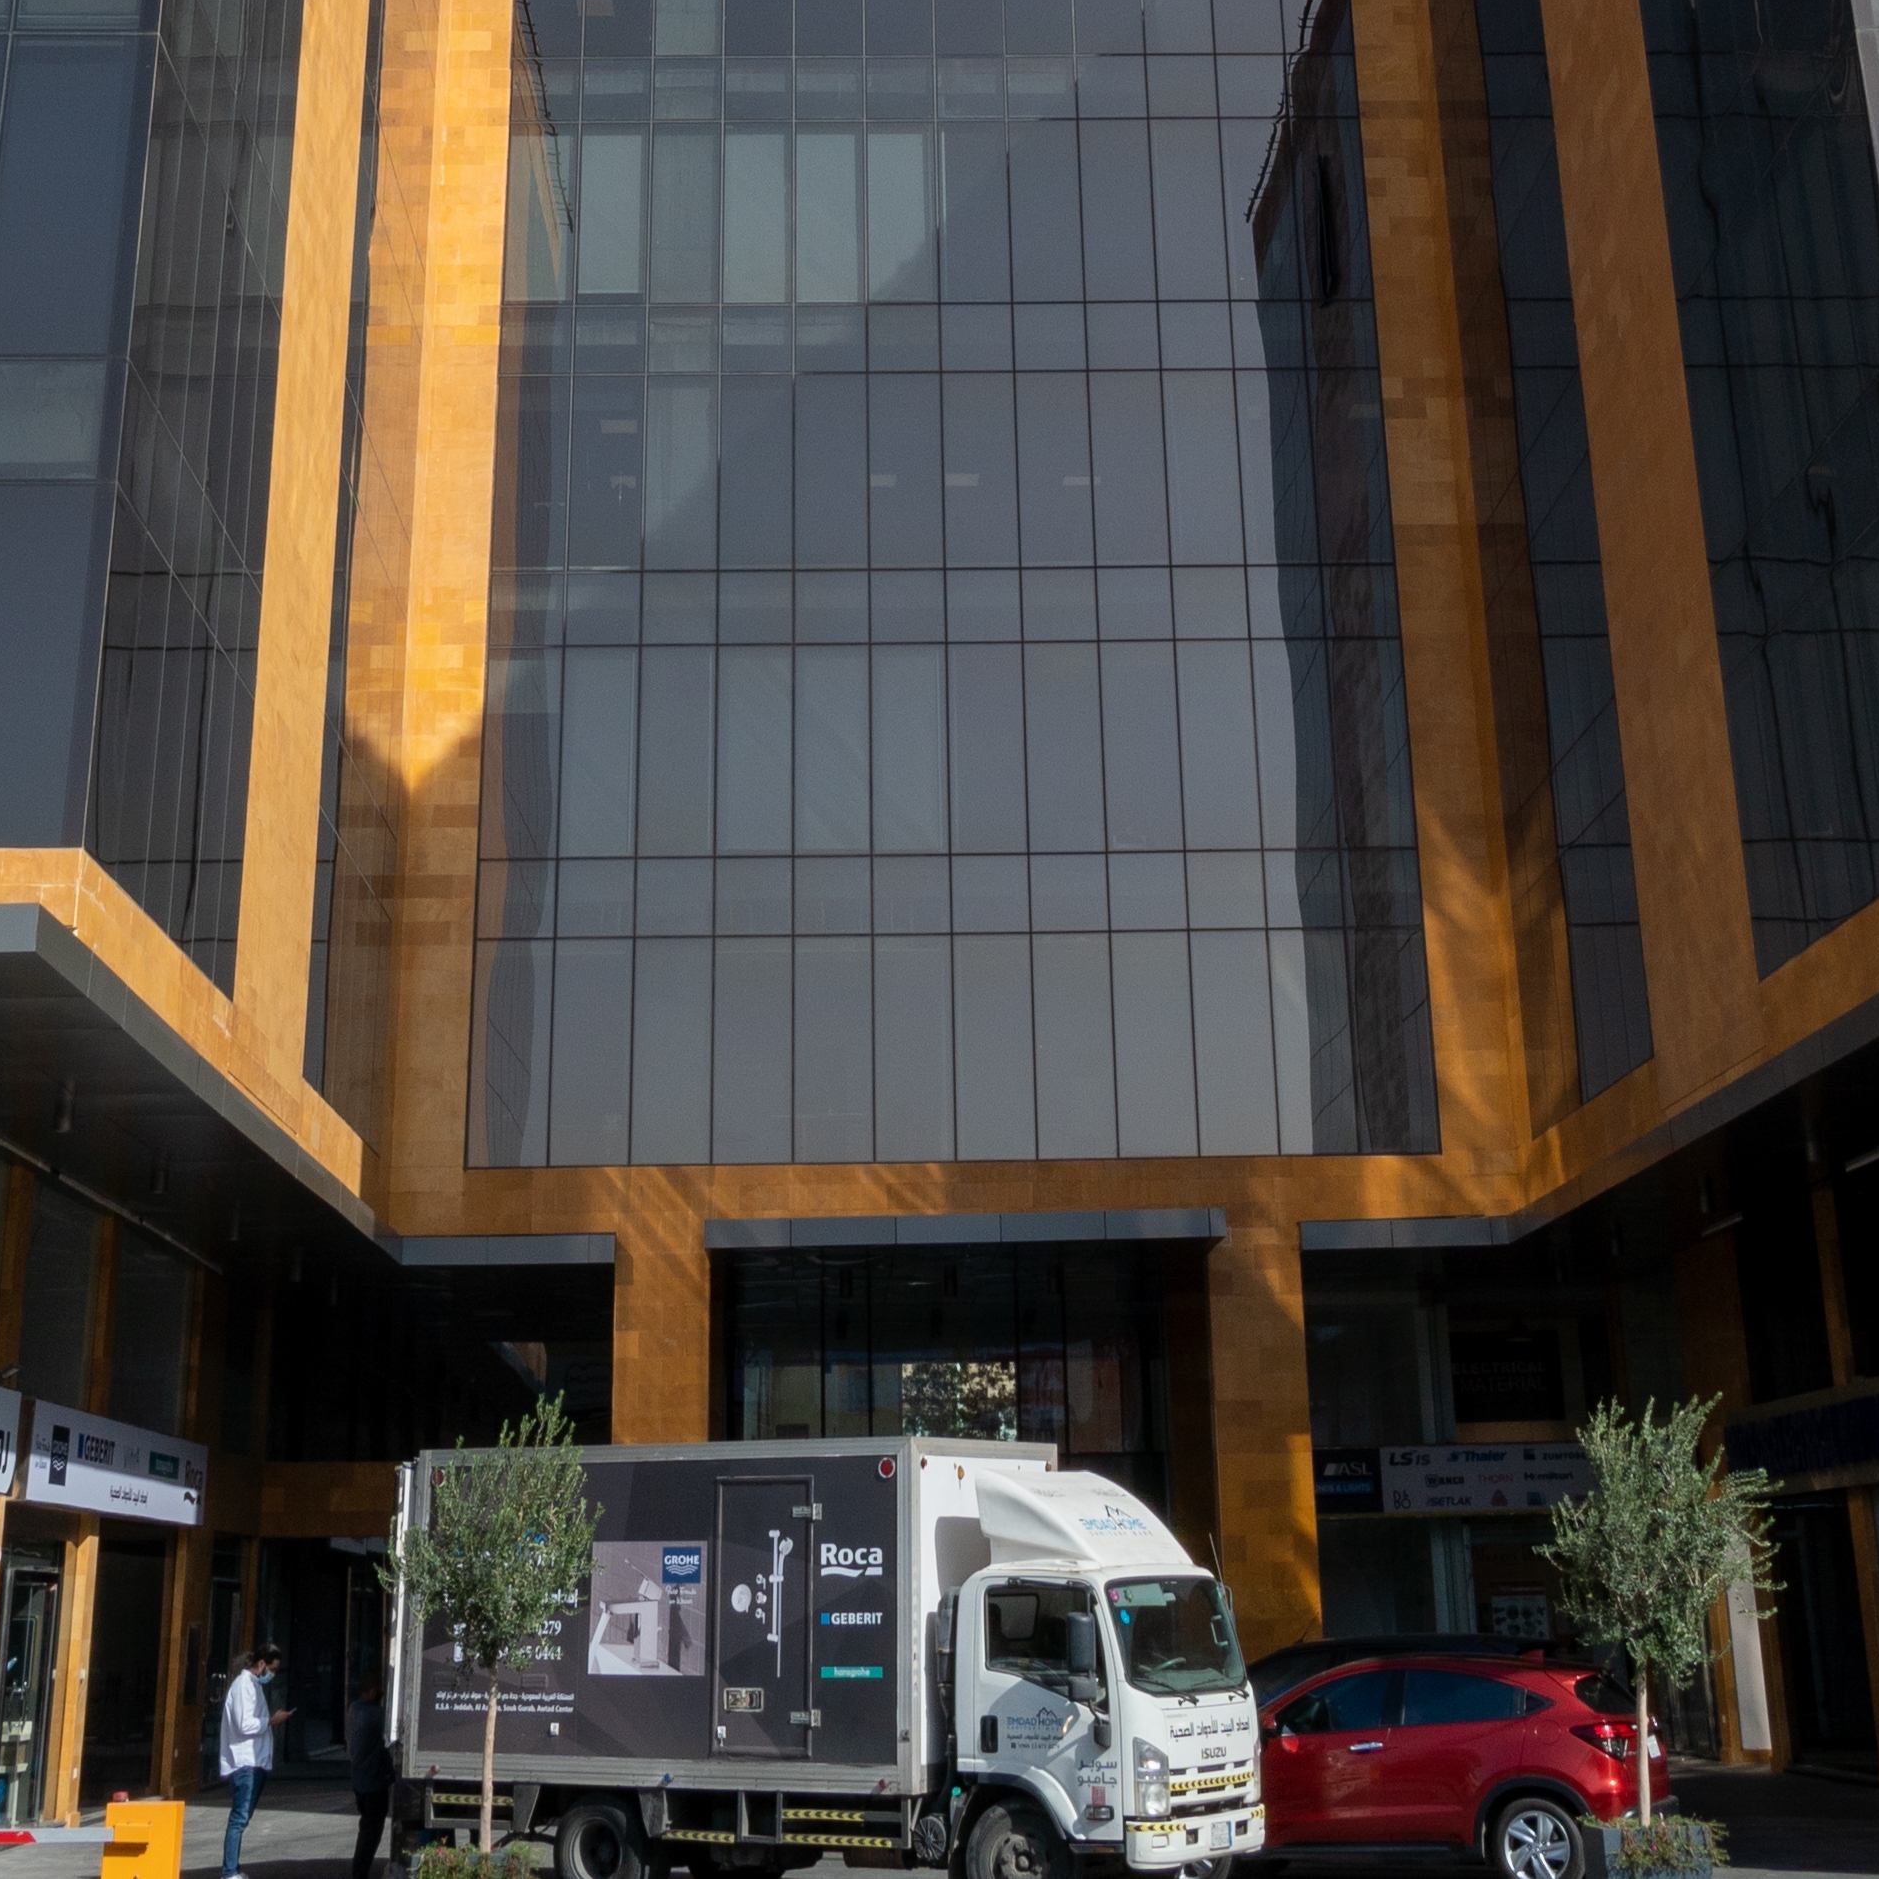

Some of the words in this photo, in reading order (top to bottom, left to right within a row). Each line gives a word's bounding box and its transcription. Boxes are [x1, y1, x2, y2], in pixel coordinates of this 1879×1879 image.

[84, 1435, 115, 1466] GEBERIT
[1464, 1450, 1507, 1462] Thaler
[1542, 1452, 1587, 1460] ZUMTOBE
[1337, 1462, 1372, 1476] ASL
[1477, 1473, 1514, 1483] THORN
[664, 1555, 700, 1565] GROHE
[821, 1543, 883, 1565] Roca
[831, 1612, 883, 1625] GEBERIT
[834, 1667, 870, 1678] hansgrohe
[1201, 1746, 1227, 1760] ISUZU
